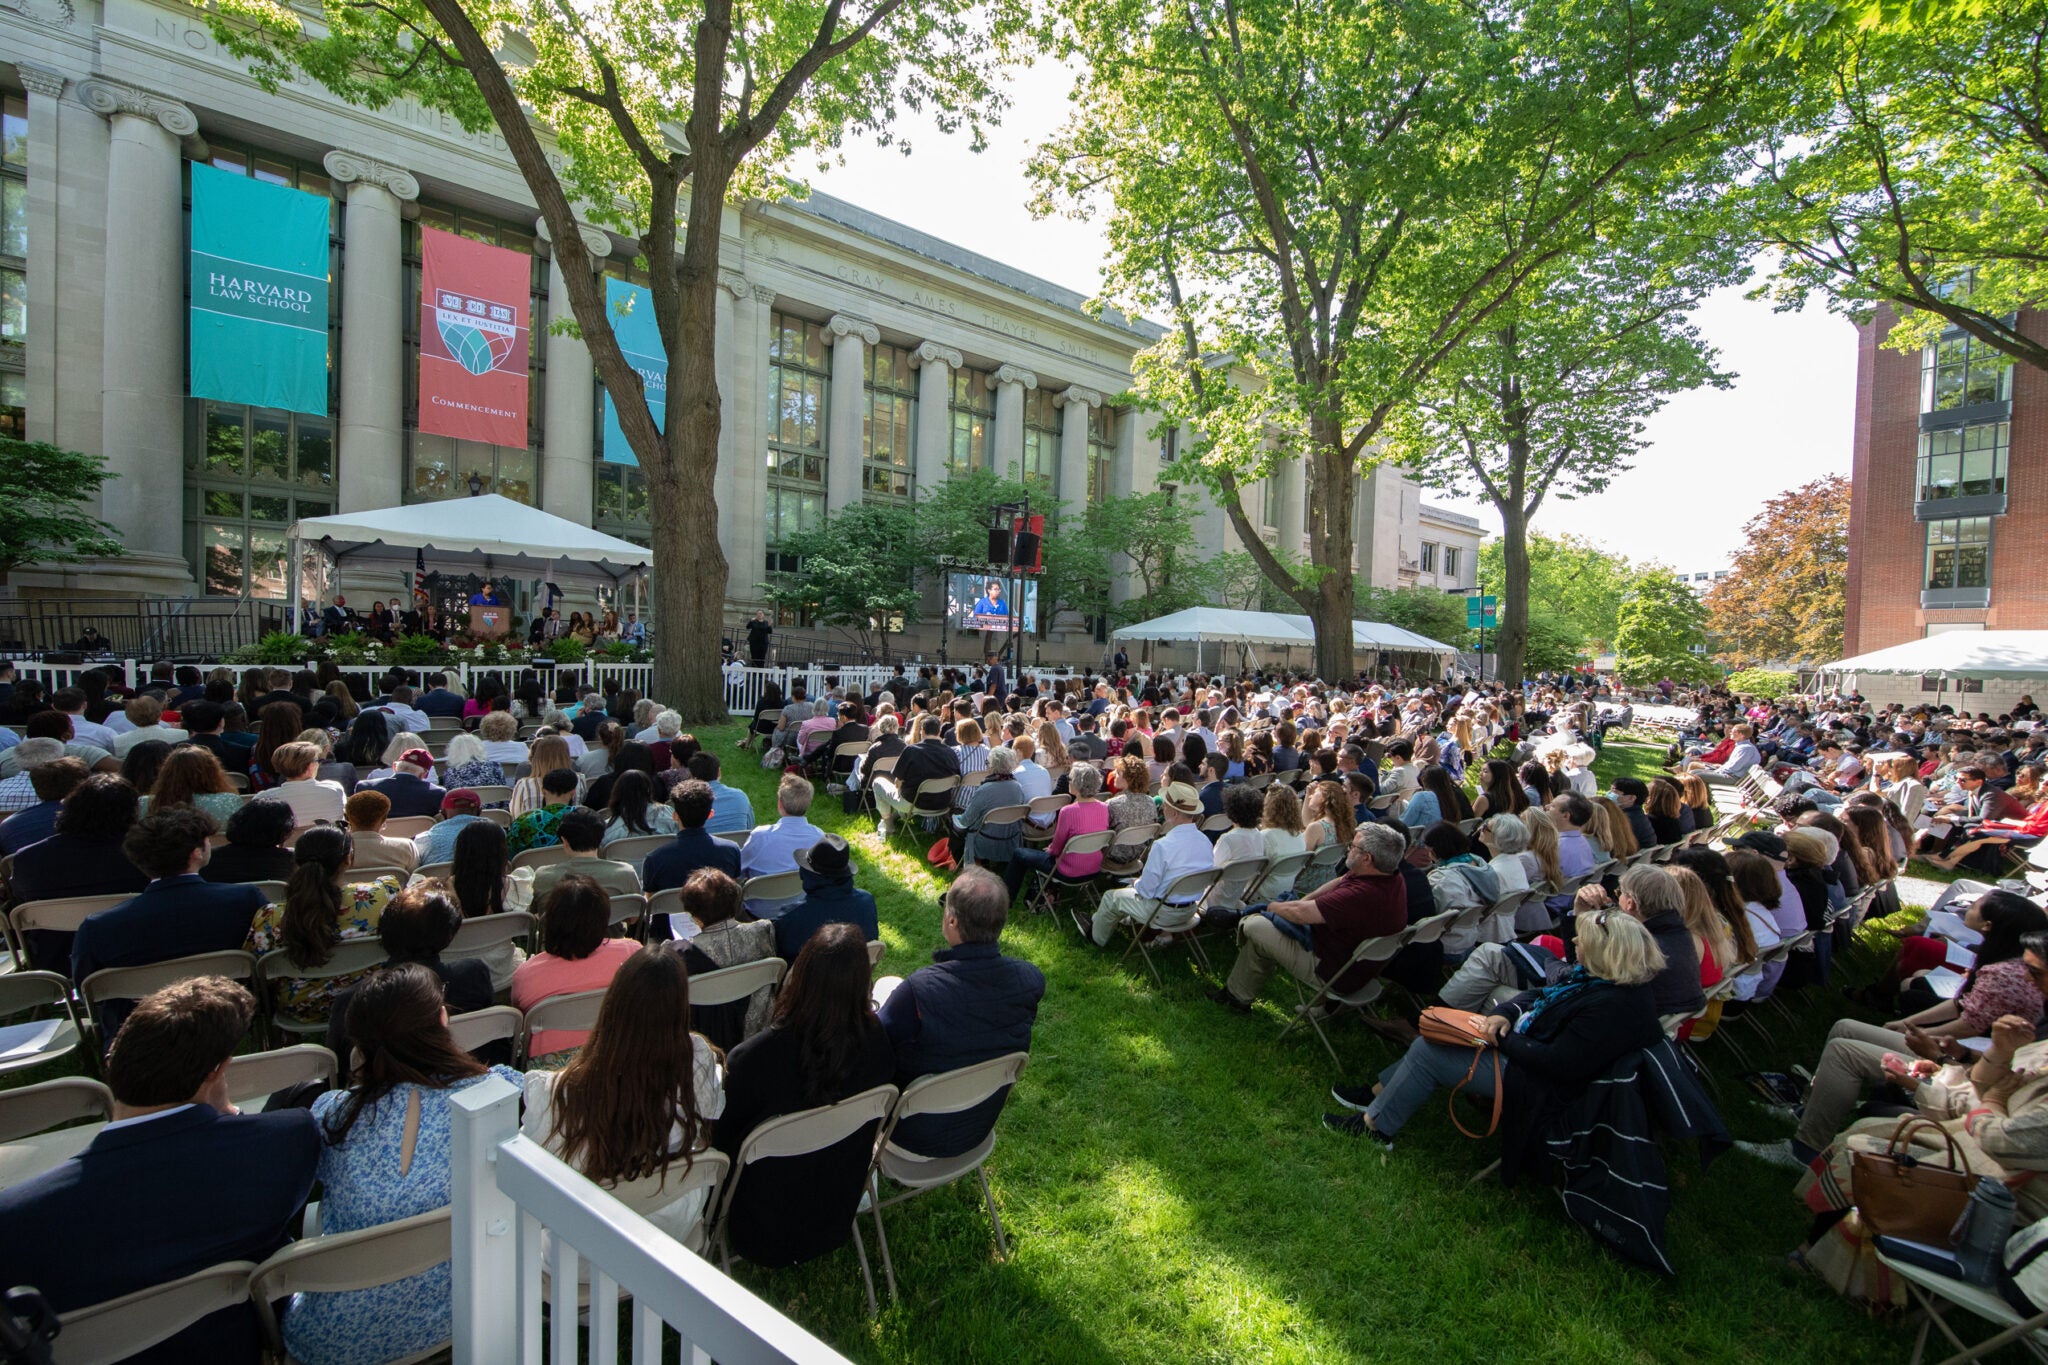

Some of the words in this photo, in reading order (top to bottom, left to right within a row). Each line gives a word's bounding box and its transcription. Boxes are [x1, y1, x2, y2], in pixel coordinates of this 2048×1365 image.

[210, 272, 312, 303] HARVARD
[210, 285, 243, 300] LAW
[248, 294, 311, 314] SCHOOL
[443, 312, 458, 321] LEX
[475, 319, 510, 333] IUSTITIA
[837, 265, 884, 287] GRAY
[913, 291, 955, 315] AMES
[982, 313, 1037, 341] THAYER
[1060, 341, 1099, 360] SMITH
[431, 395, 517, 419] COMMENCEMENT
